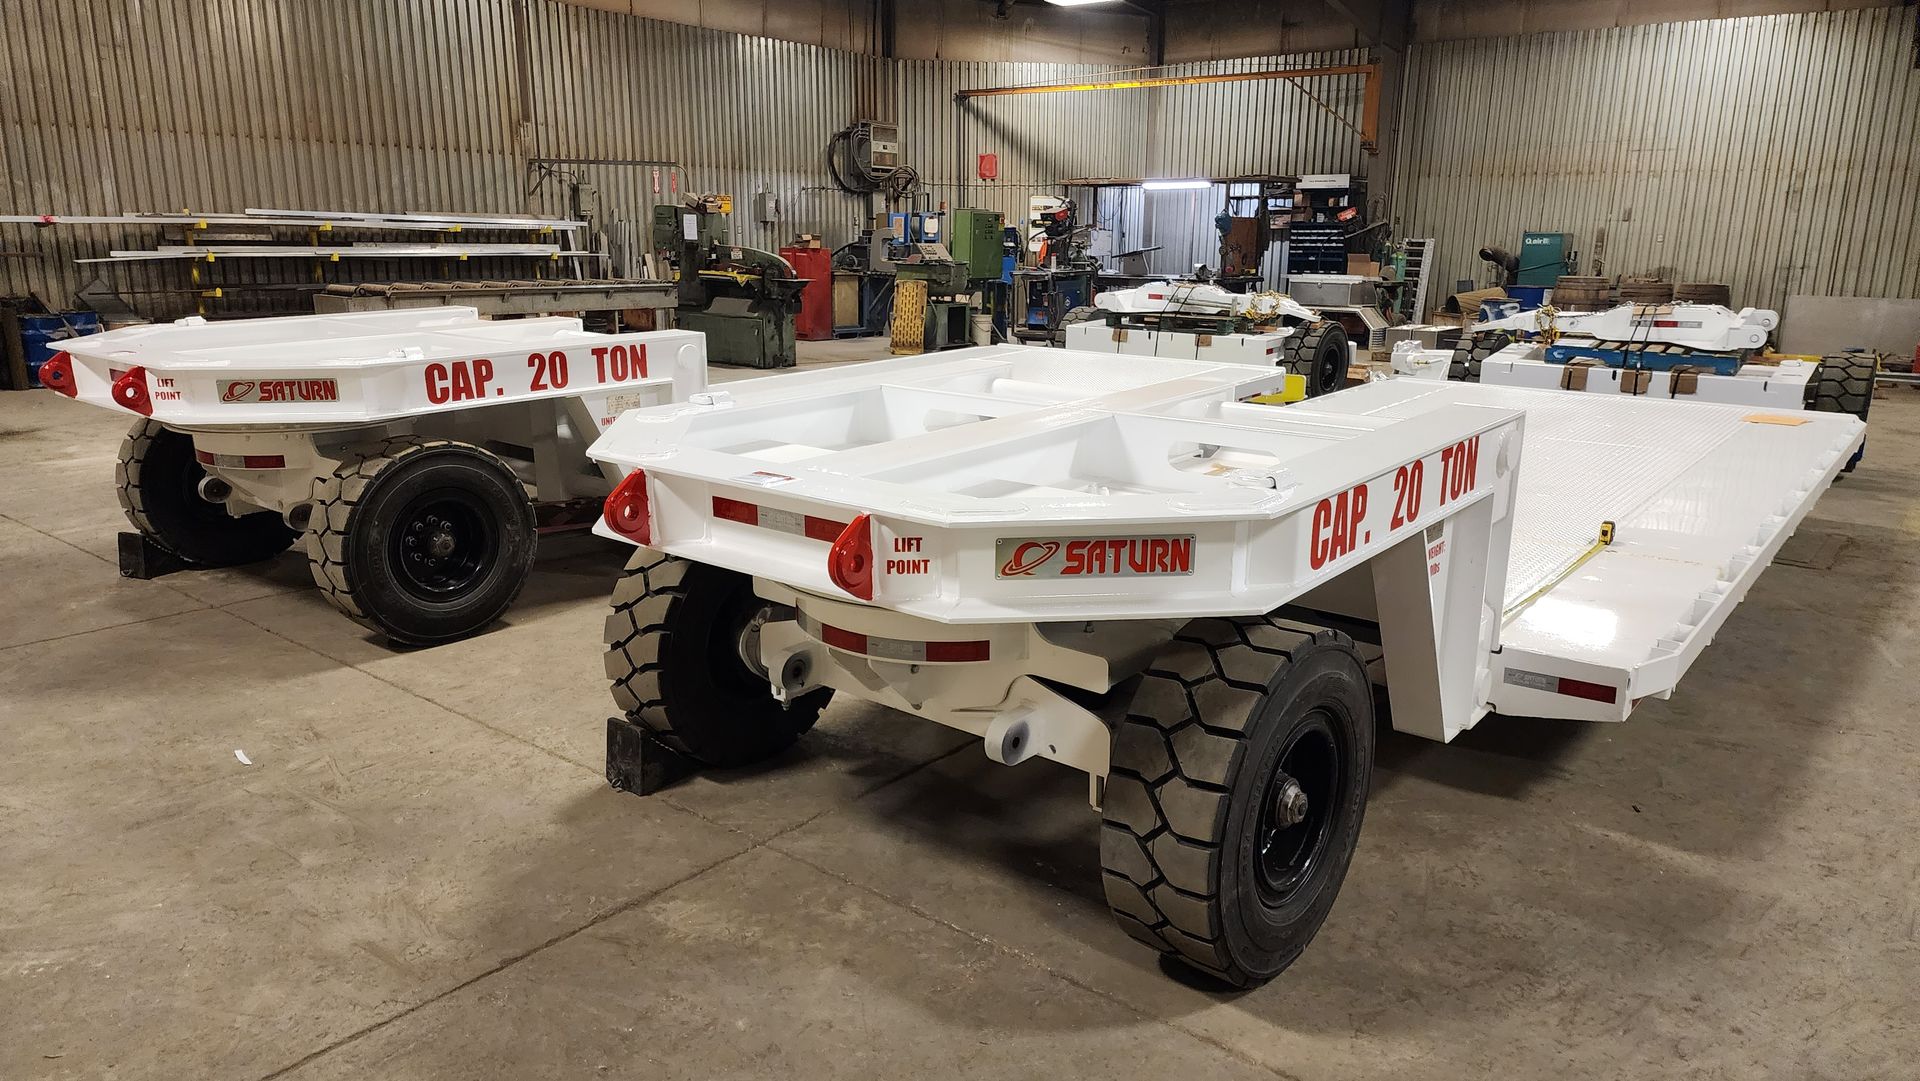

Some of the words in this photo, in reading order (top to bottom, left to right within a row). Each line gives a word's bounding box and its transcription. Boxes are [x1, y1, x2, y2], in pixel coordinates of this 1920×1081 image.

[157, 377, 176, 388] LIFT
[425, 359, 503, 404] CAP.
[528, 351, 568, 391] 20
[592, 343, 648, 383] TON
[153, 391, 183, 400] POINT
[259, 380, 336, 401] SATURN
[1310, 484, 1370, 570] CAP.
[1390, 459, 1423, 529] 20
[1440, 436, 1478, 505] TON
[894, 536, 921, 553] LIFT
[1060, 538, 1190, 575] SATURN
[886, 559, 929, 575] POINT
